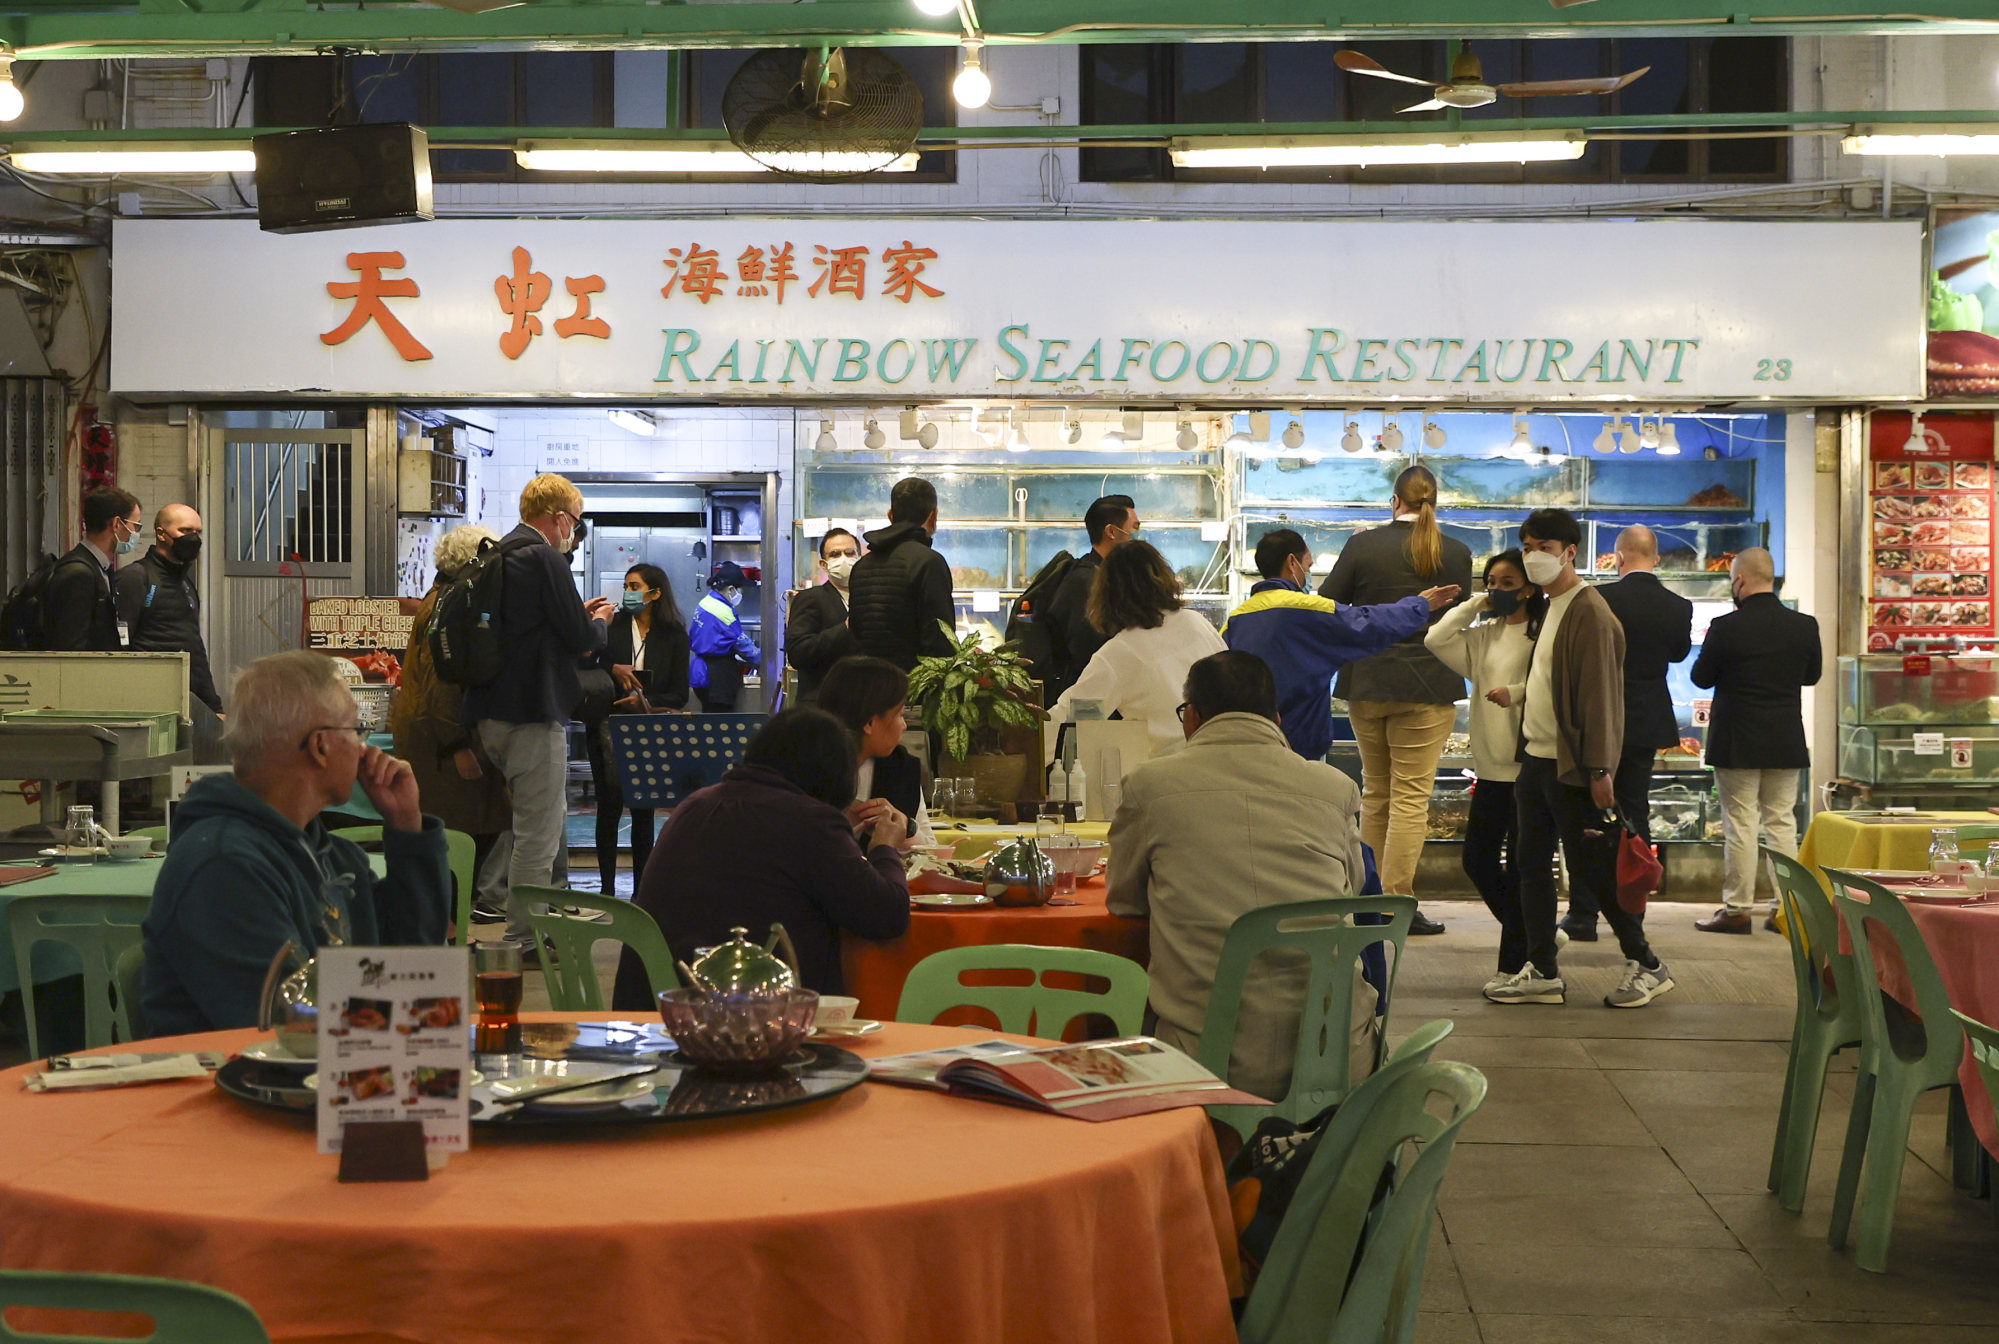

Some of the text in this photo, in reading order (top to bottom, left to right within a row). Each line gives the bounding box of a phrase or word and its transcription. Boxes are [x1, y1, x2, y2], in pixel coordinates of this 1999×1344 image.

[661, 241, 945, 304] 海鮮酒家
[320, 246, 612, 362] 天虹
[654, 325, 1793, 384] RAINBOW SEAFOOD RESTAURANT 23
[310, 599, 400, 616] BAKED LOBSTER
[310, 615, 340, 632] WITH
[341, 615, 381, 632] TRIPLE
